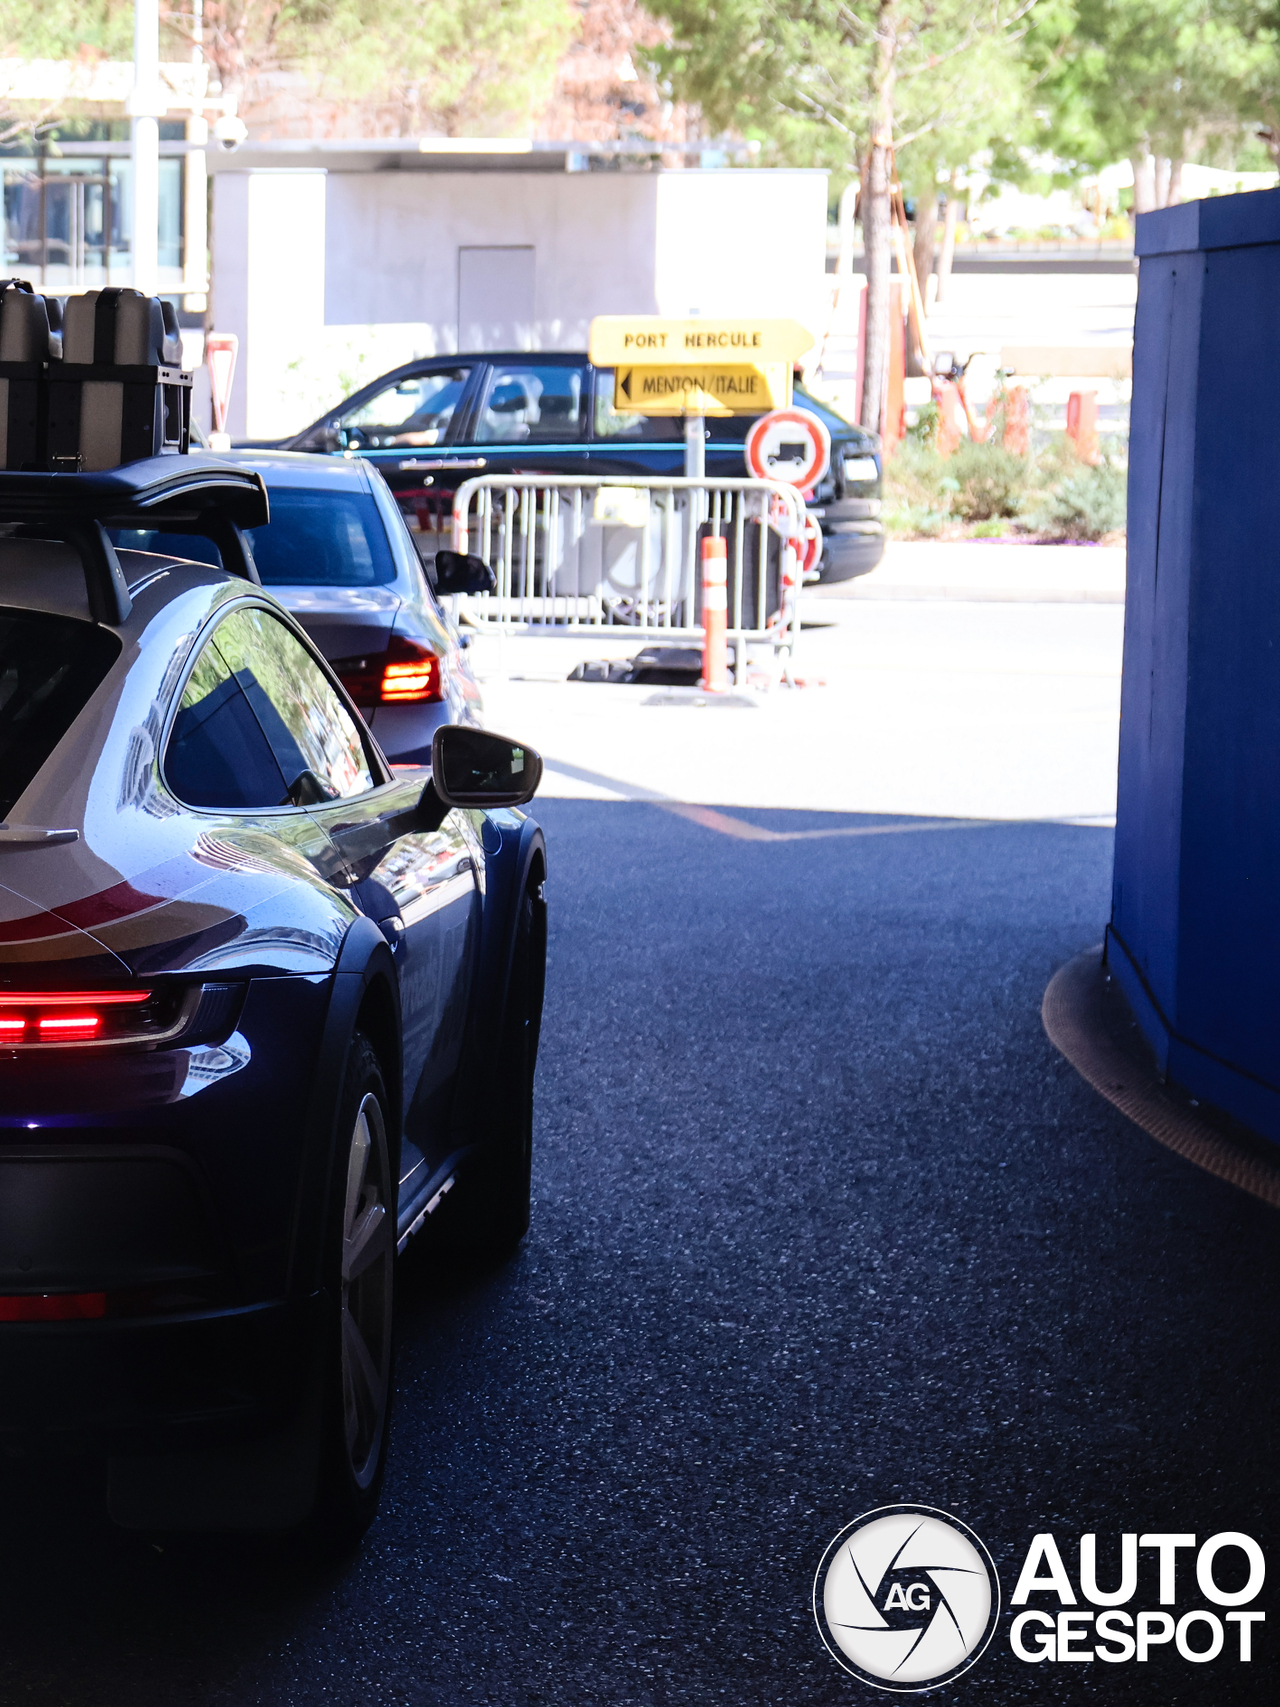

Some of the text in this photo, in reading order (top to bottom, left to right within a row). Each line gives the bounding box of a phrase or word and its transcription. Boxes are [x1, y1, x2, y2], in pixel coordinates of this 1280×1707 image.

[624, 332, 761, 348] PORT HERCULE
[643, 375, 758, 394] MENTON/ITALIE
